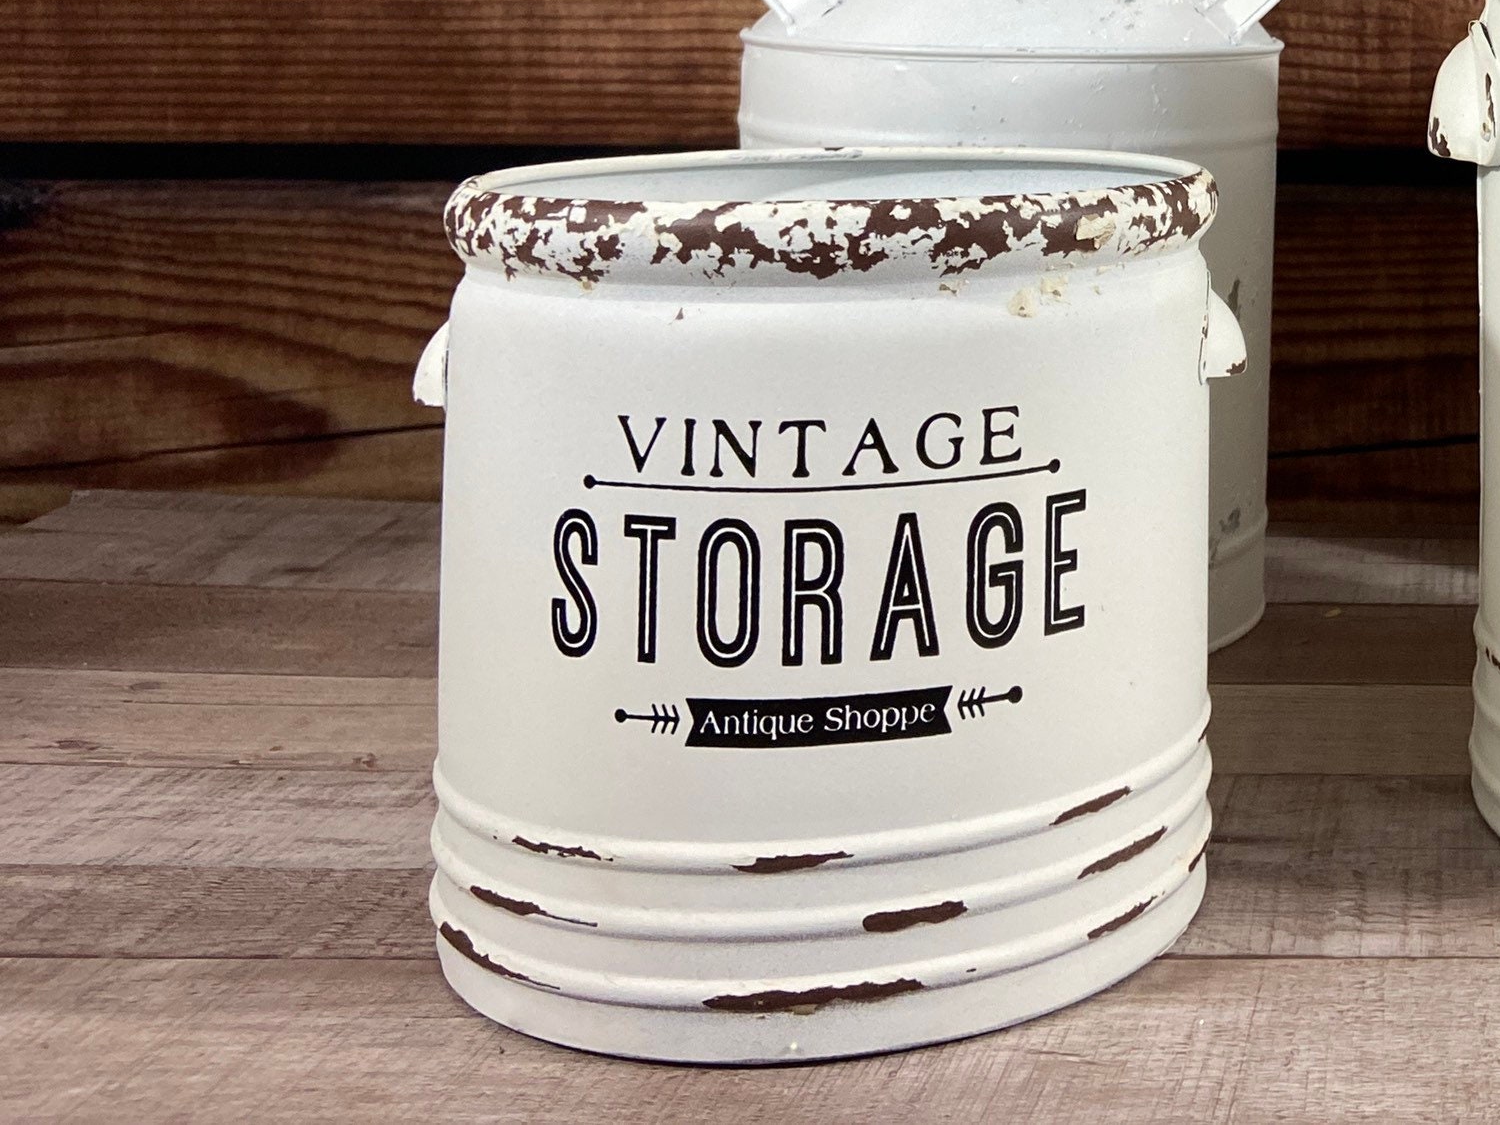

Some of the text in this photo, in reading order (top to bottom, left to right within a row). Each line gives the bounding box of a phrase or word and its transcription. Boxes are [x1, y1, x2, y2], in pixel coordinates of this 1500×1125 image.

[617, 405, 1022, 479] VINTAGE
[551, 488, 1087, 669] STORAGE
[699, 702, 936, 741] Antique Shoppe
